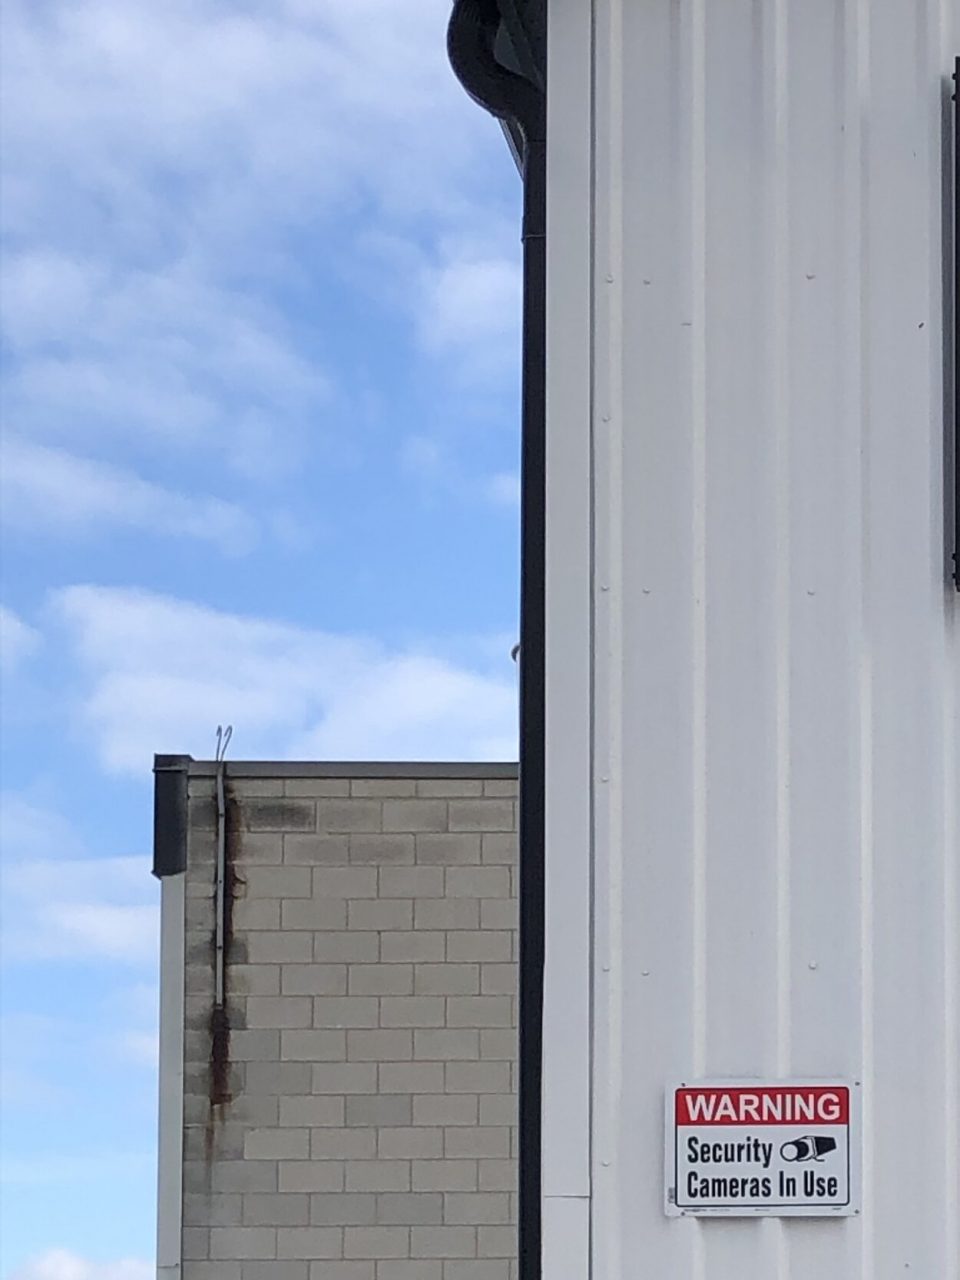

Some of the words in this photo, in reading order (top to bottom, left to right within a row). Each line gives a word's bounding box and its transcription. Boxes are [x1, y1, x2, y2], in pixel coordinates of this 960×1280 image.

[685, 1093, 841, 1121] WARNING
[687, 1136, 773, 1168] Security
[687, 1171, 772, 1198] Cameras
[779, 1171, 796, 1197] In
[804, 1170, 838, 1197] Use
